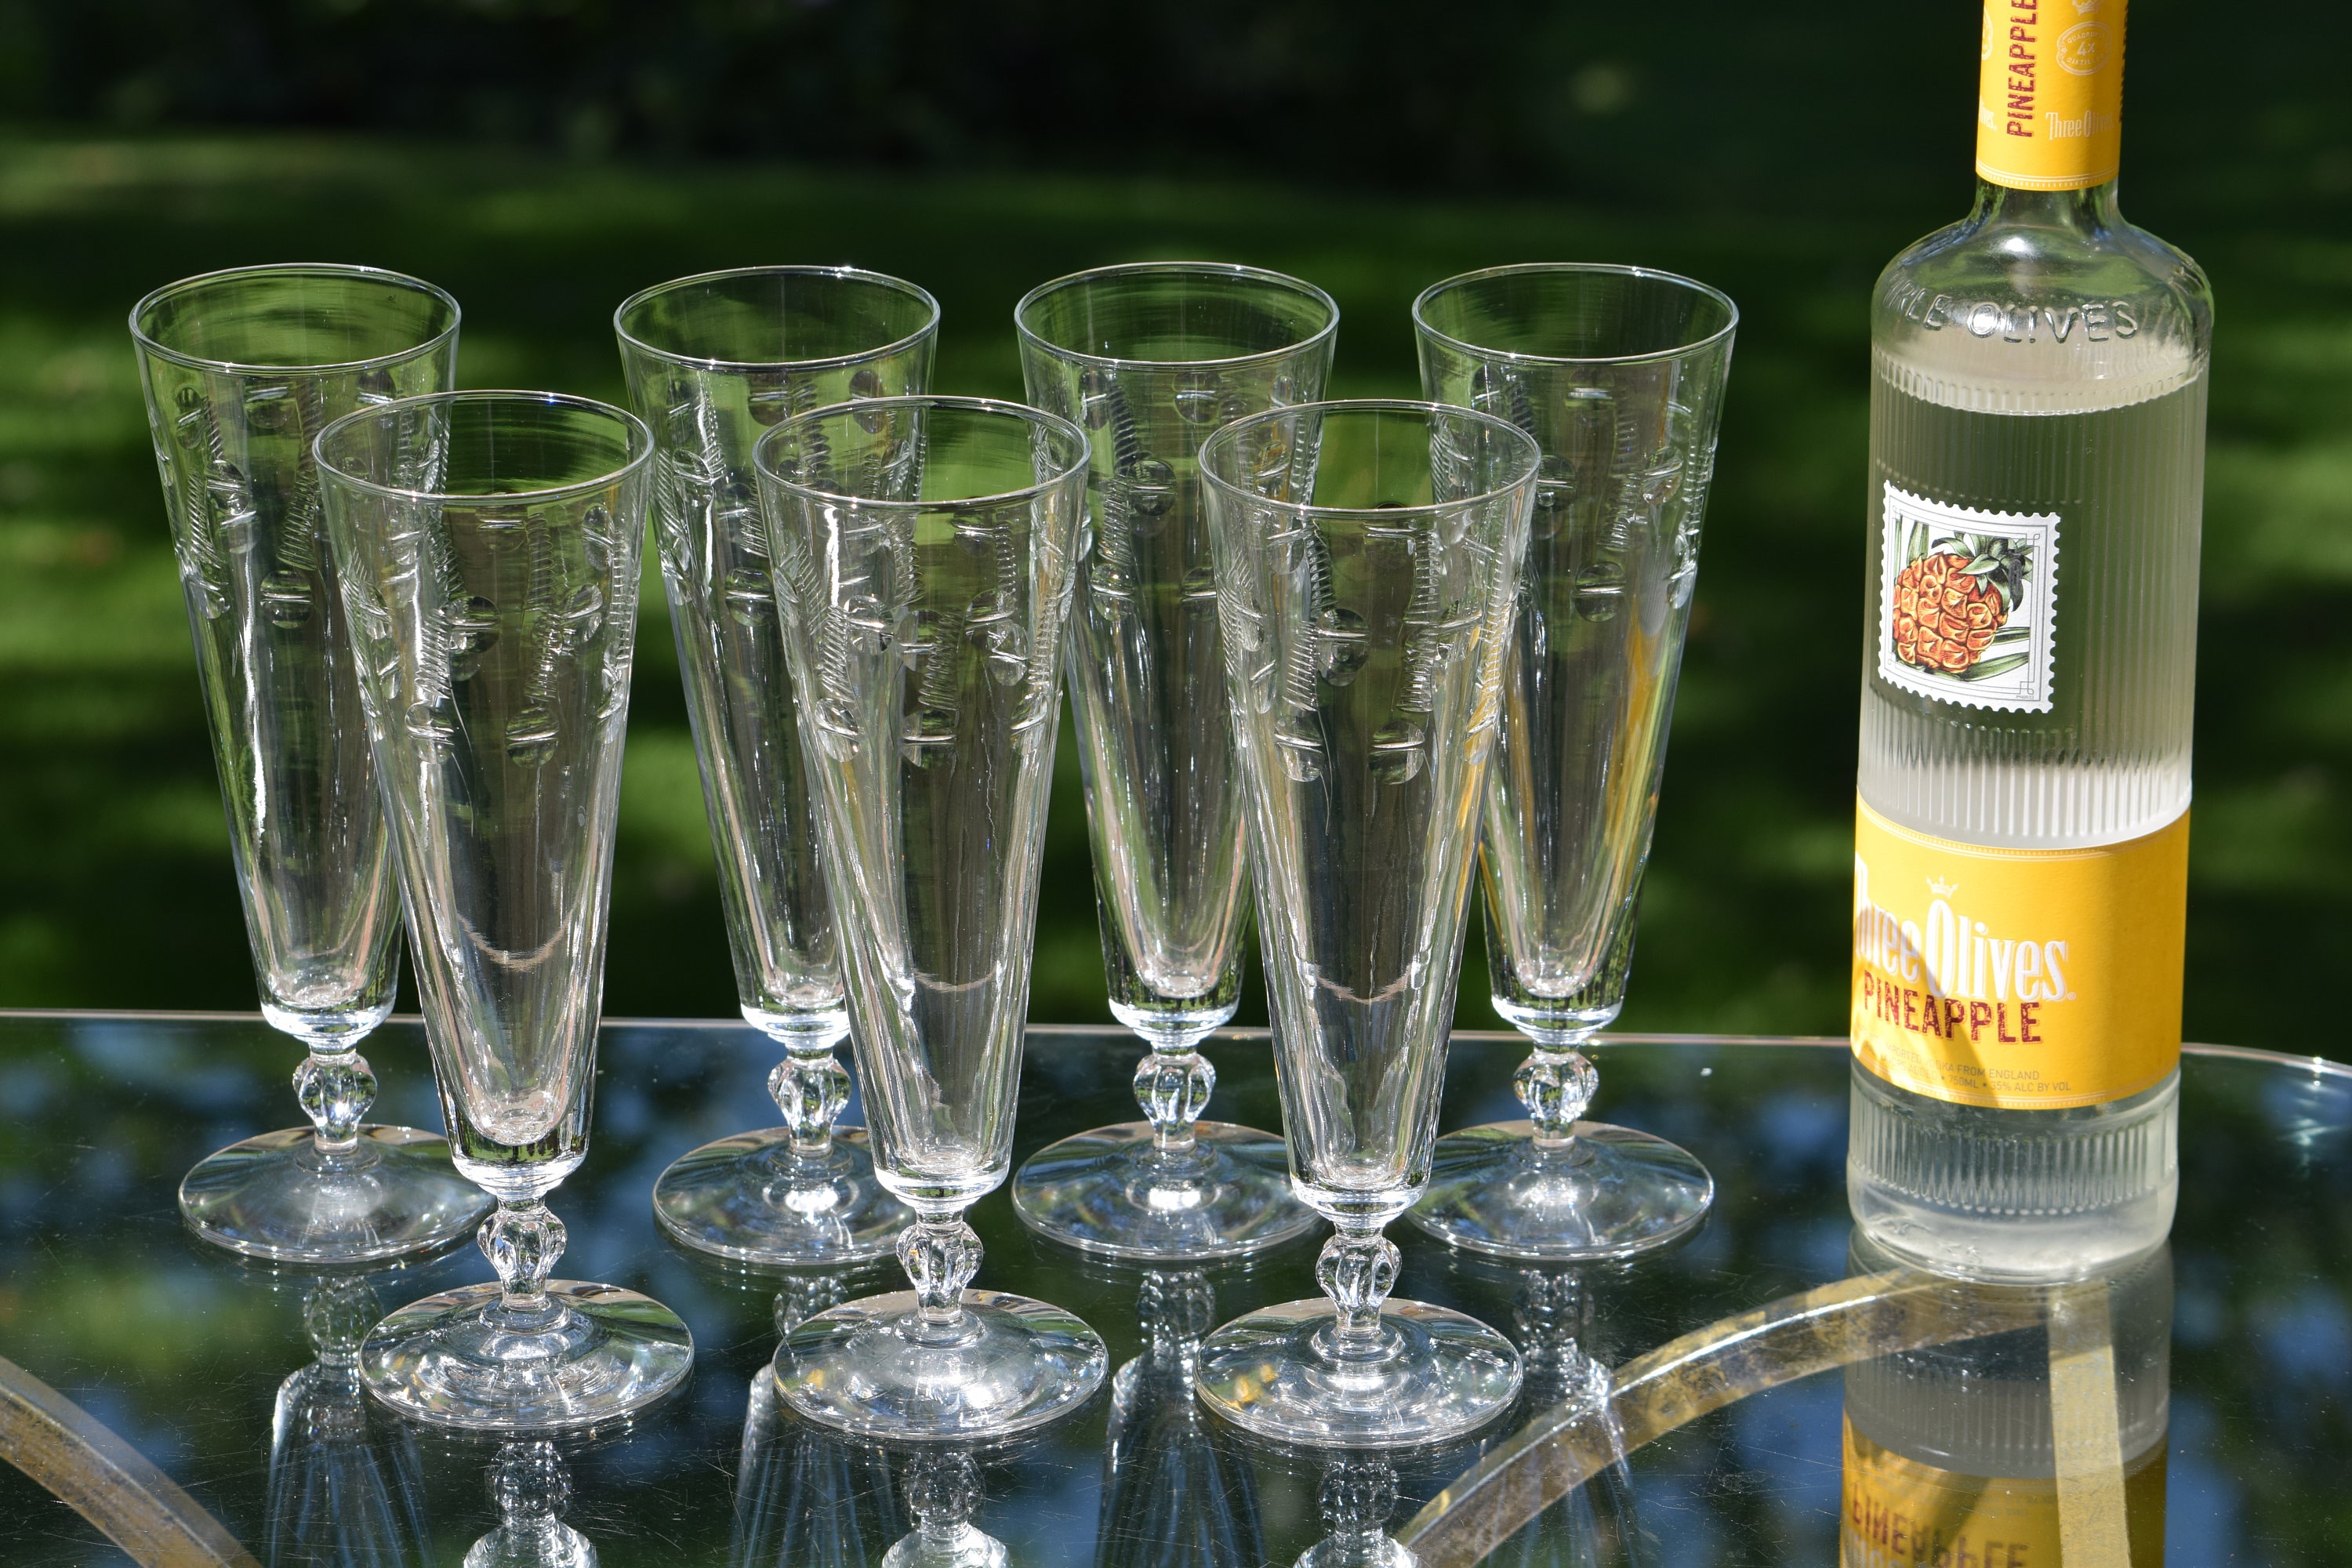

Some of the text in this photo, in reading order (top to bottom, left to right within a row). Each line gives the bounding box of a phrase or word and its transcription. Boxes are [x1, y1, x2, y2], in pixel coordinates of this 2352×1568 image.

[2007, 0, 2037, 137] PINEAPPLE
[2045, 109, 2115, 140] Three Olives
[1966, 300, 2139, 344] OLIVES
[1926, 899, 2069, 1001] Olives
[1864, 969, 2042, 1044] PINEAPPLE
[1948, 1075, 1979, 1089] 750ML
[1991, 1081, 2011, 1091] 35%
[2014, 1083, 2034, 1092] ALC
[2038, 1083, 2050, 1092] BY
[2053, 1082, 2071, 1091] VOL
[1957, 1065, 1985, 1077] FROM
[1989, 1069, 2040, 1080] ENGLAND
